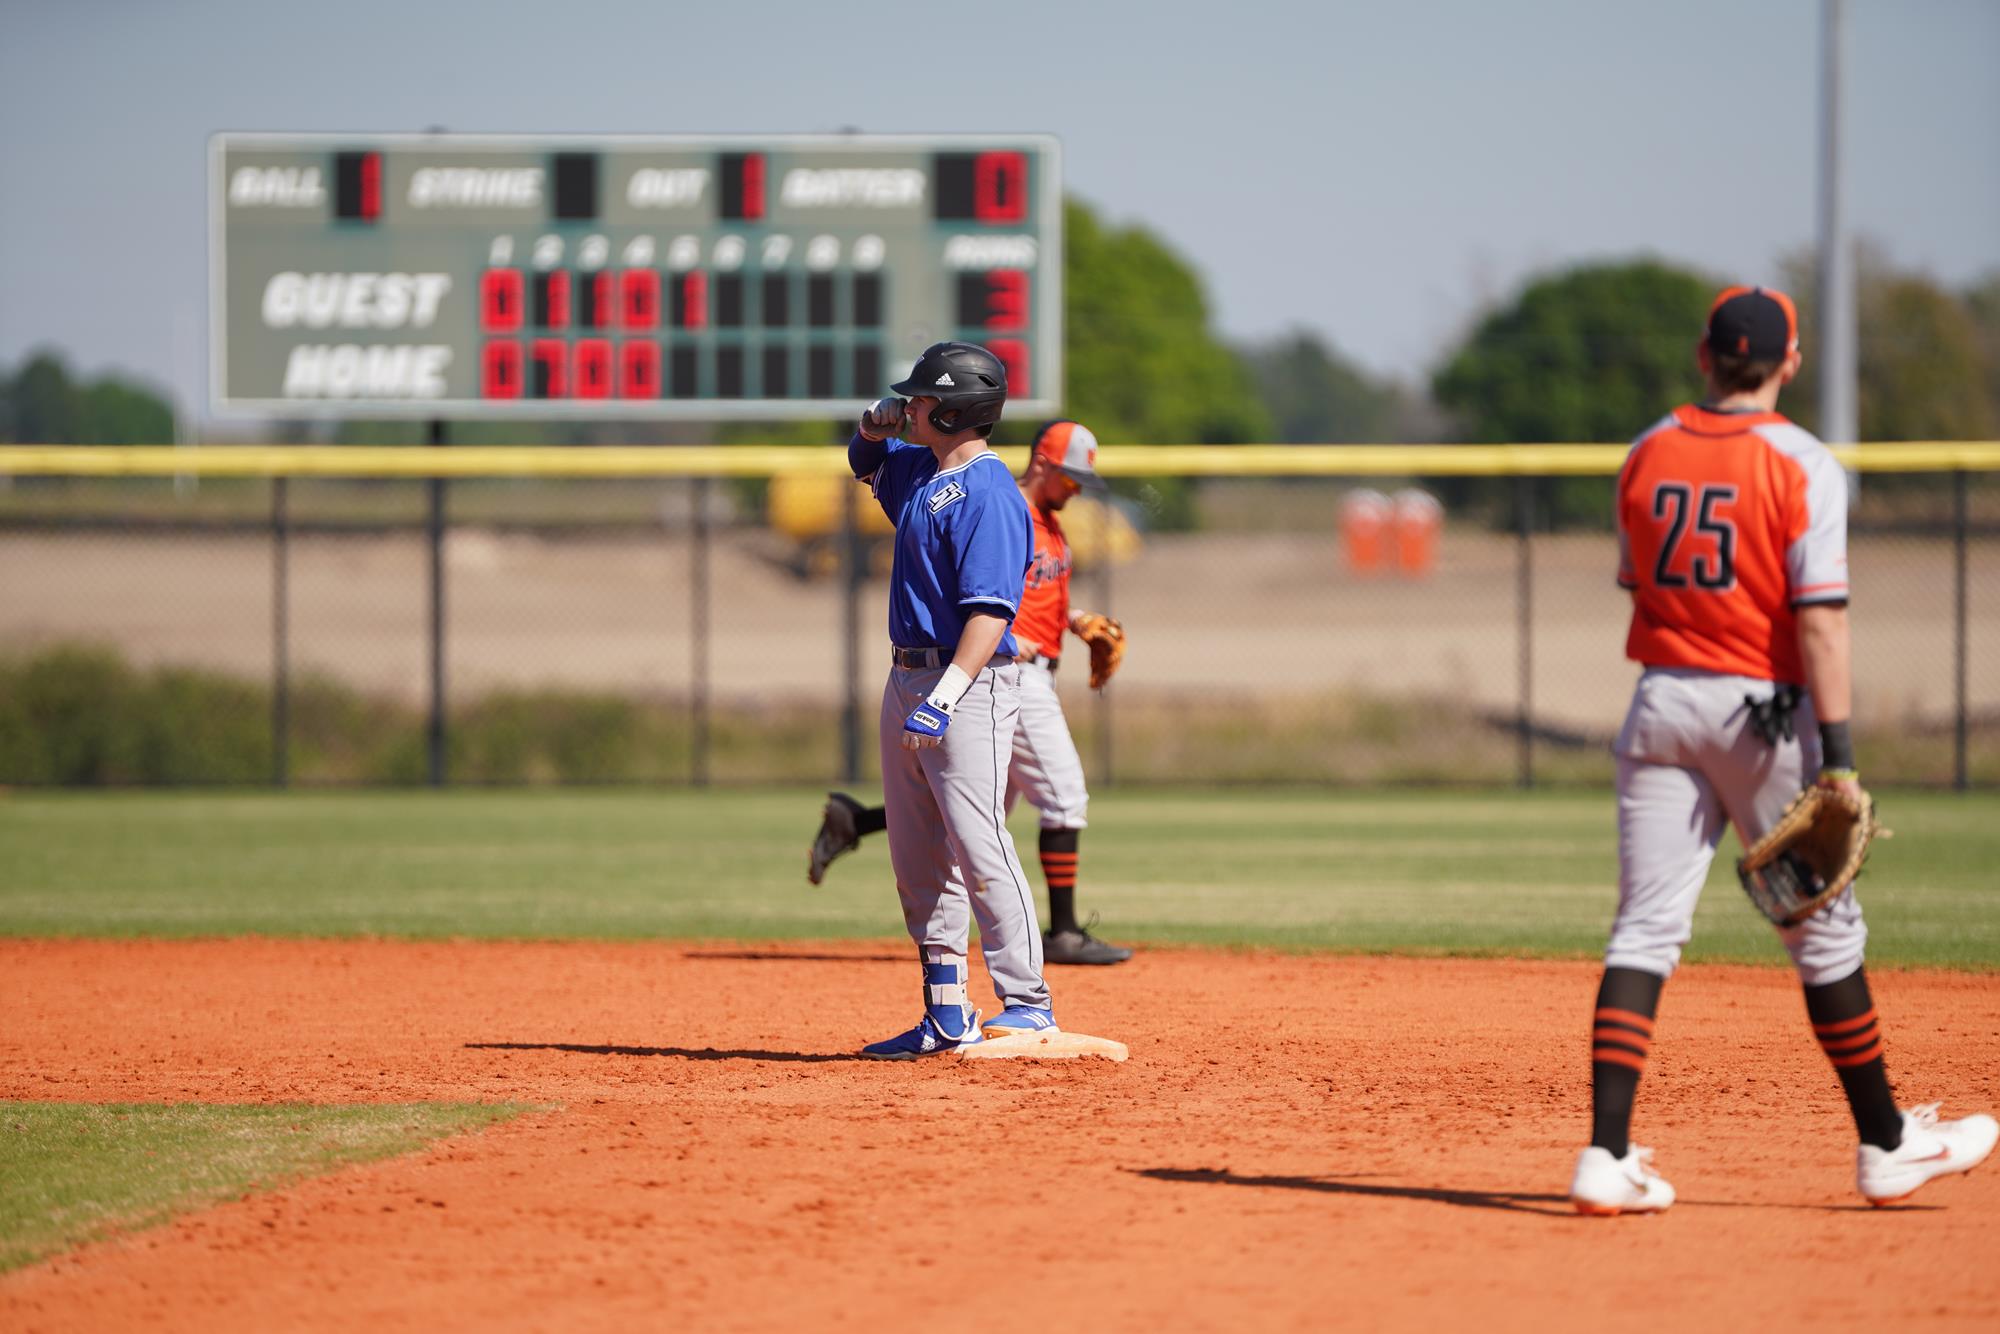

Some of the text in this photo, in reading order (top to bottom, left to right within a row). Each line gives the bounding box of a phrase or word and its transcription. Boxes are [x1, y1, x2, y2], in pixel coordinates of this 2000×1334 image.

[229, 165, 325, 207] BALL
[360, 151, 383, 224] 1
[408, 167, 545, 209] STRIKE
[627, 167, 709, 207] OUT
[741, 151, 766, 223] 1
[781, 168, 926, 207] BATTER
[974, 150, 1030, 225] 0
[261, 271, 452, 329] GUEST
[480, 267, 708, 334] 0 1 1 0 1
[983, 267, 1030, 333] 3
[283, 344, 453, 399] HOME
[480, 337, 525, 402] 0
[571, 337, 615, 402] 0
[617, 337, 661, 402] 0
[1653, 481, 1739, 591] 25
